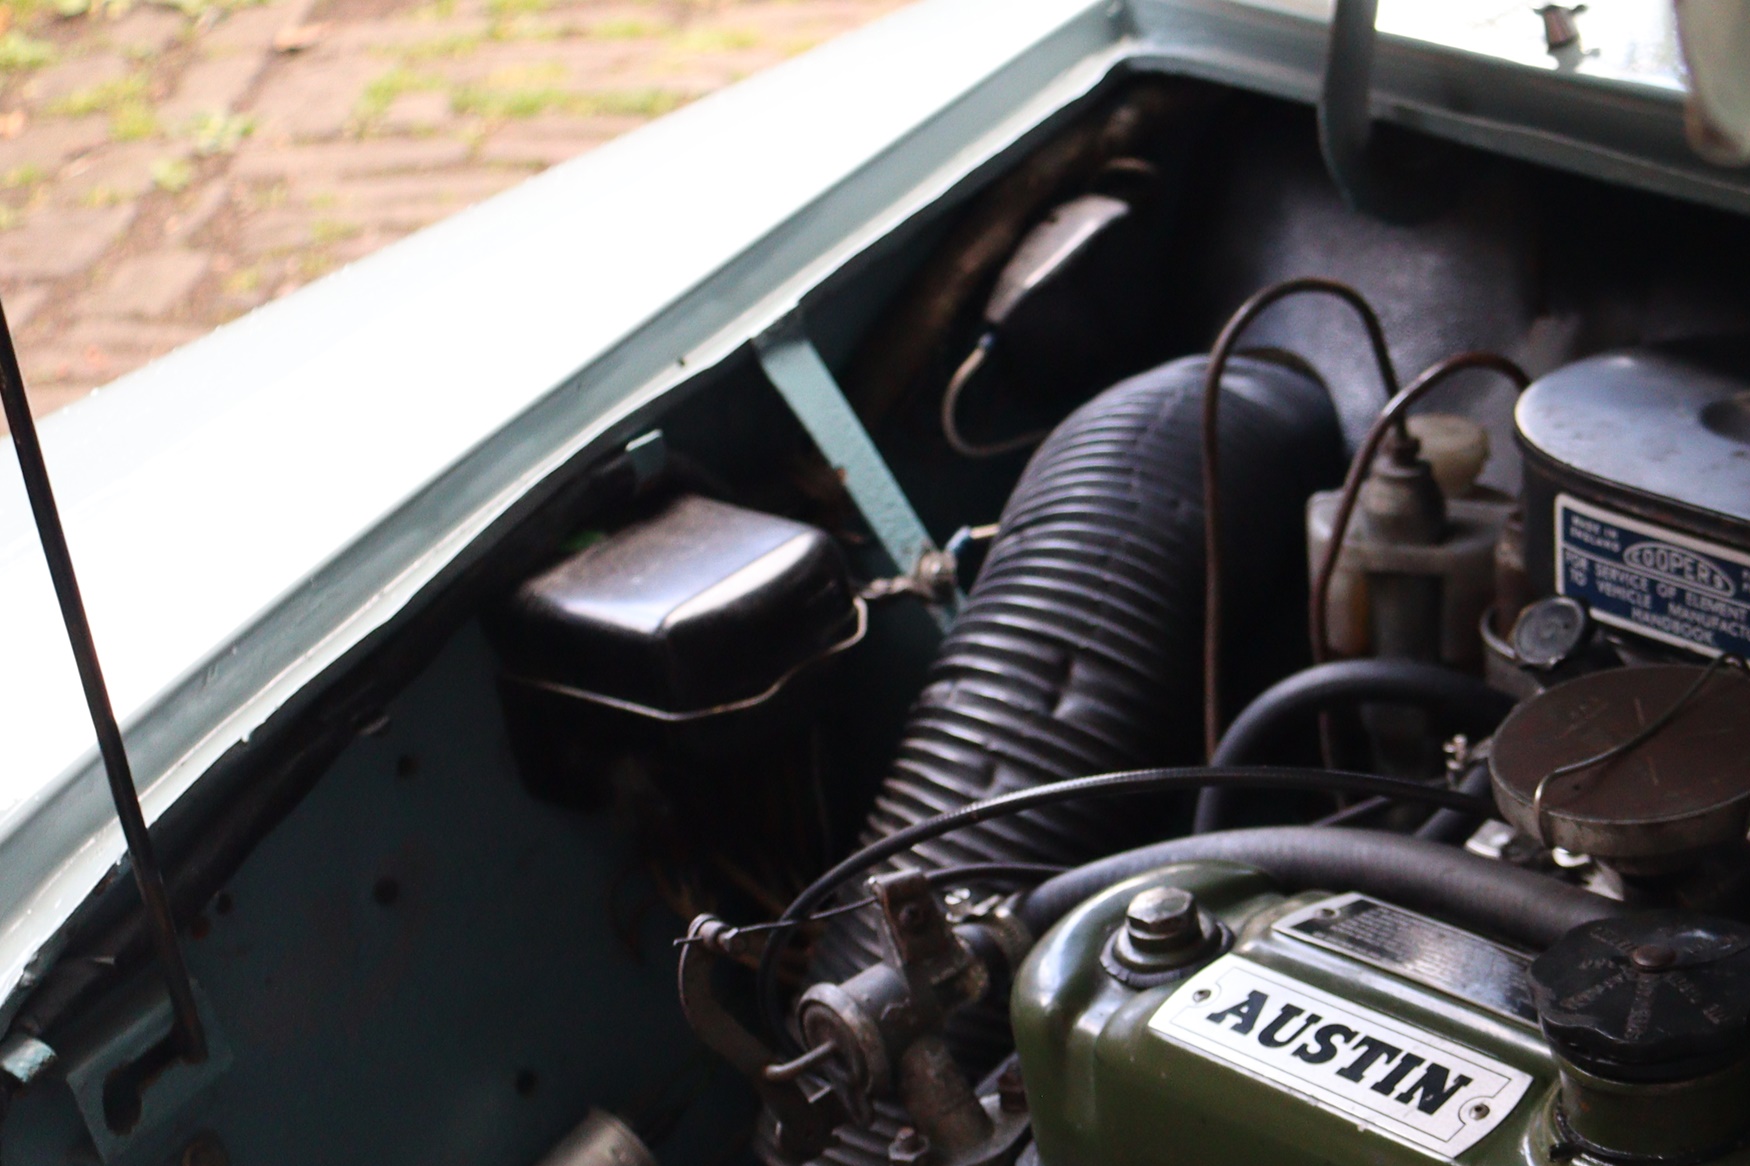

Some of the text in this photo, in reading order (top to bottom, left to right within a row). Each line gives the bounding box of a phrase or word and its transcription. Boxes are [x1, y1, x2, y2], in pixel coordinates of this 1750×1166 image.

[1570, 527, 1621, 552] ENGLAND
[1564, 551, 1589, 570] FOR
[1594, 562, 1649, 592] SERVICE
[1656, 584, 1678, 599] OF
[1685, 592, 1748, 620] ELEMENT
[1570, 570, 1587, 587] TO
[1597, 583, 1652, 609] VEHICLE
[1205, 988, 1474, 1116] AUSTIN
